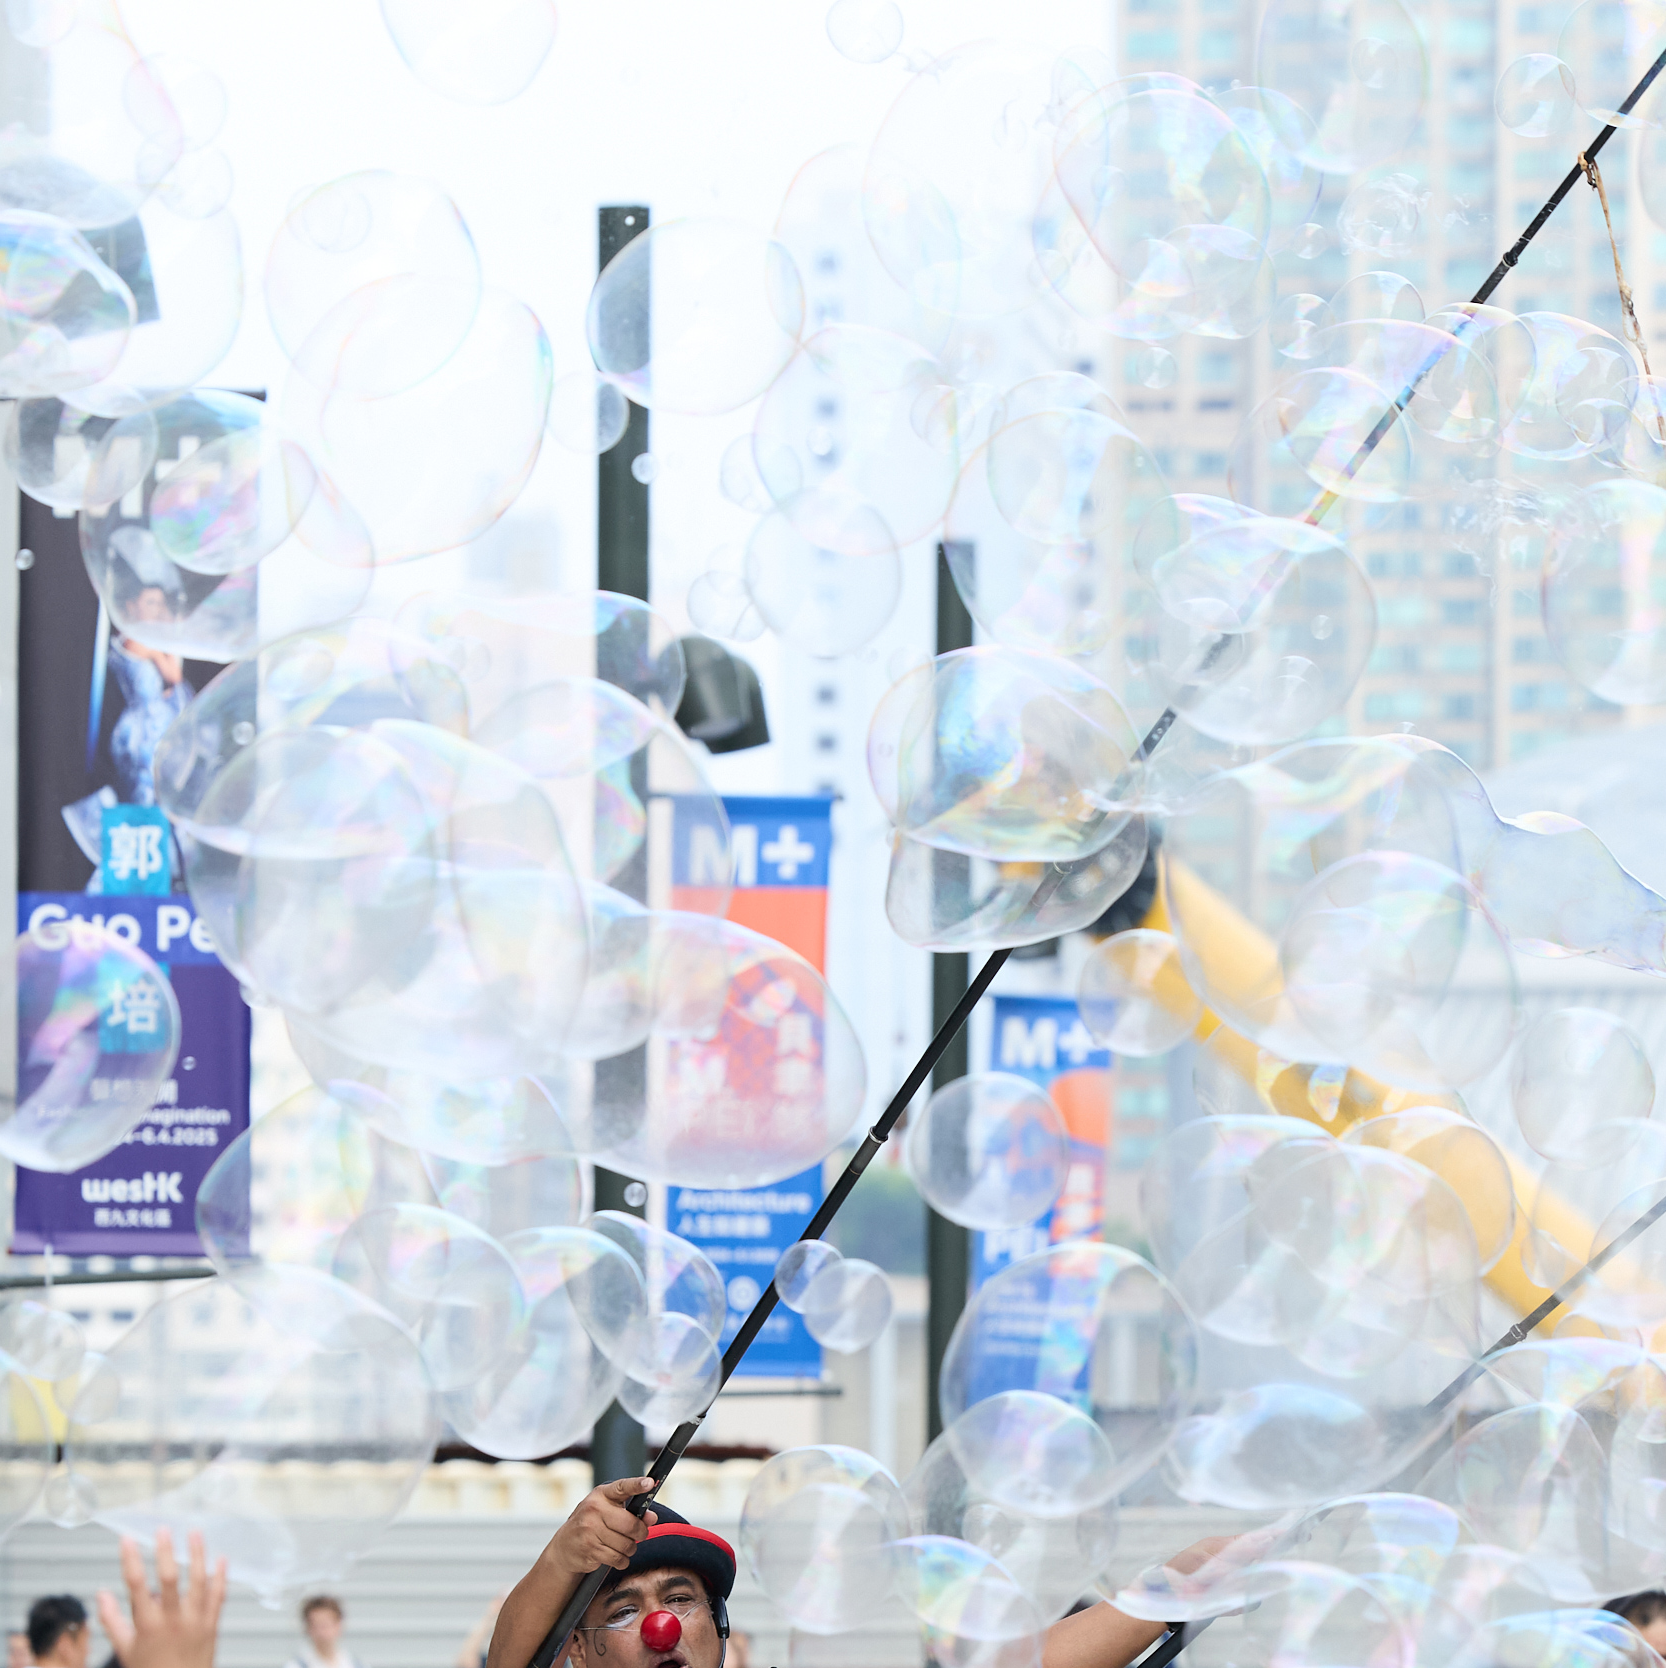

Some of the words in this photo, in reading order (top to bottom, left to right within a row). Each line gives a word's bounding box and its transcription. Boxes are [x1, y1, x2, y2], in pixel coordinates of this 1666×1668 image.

[108, 823, 163, 880] 郭
[691, 824, 814, 888] M+
[28, 903, 142, 951] Guo
[156, 905, 219, 953] Pe
[106, 981, 161, 1034] 培
[1001, 1017, 1095, 1067] M+
